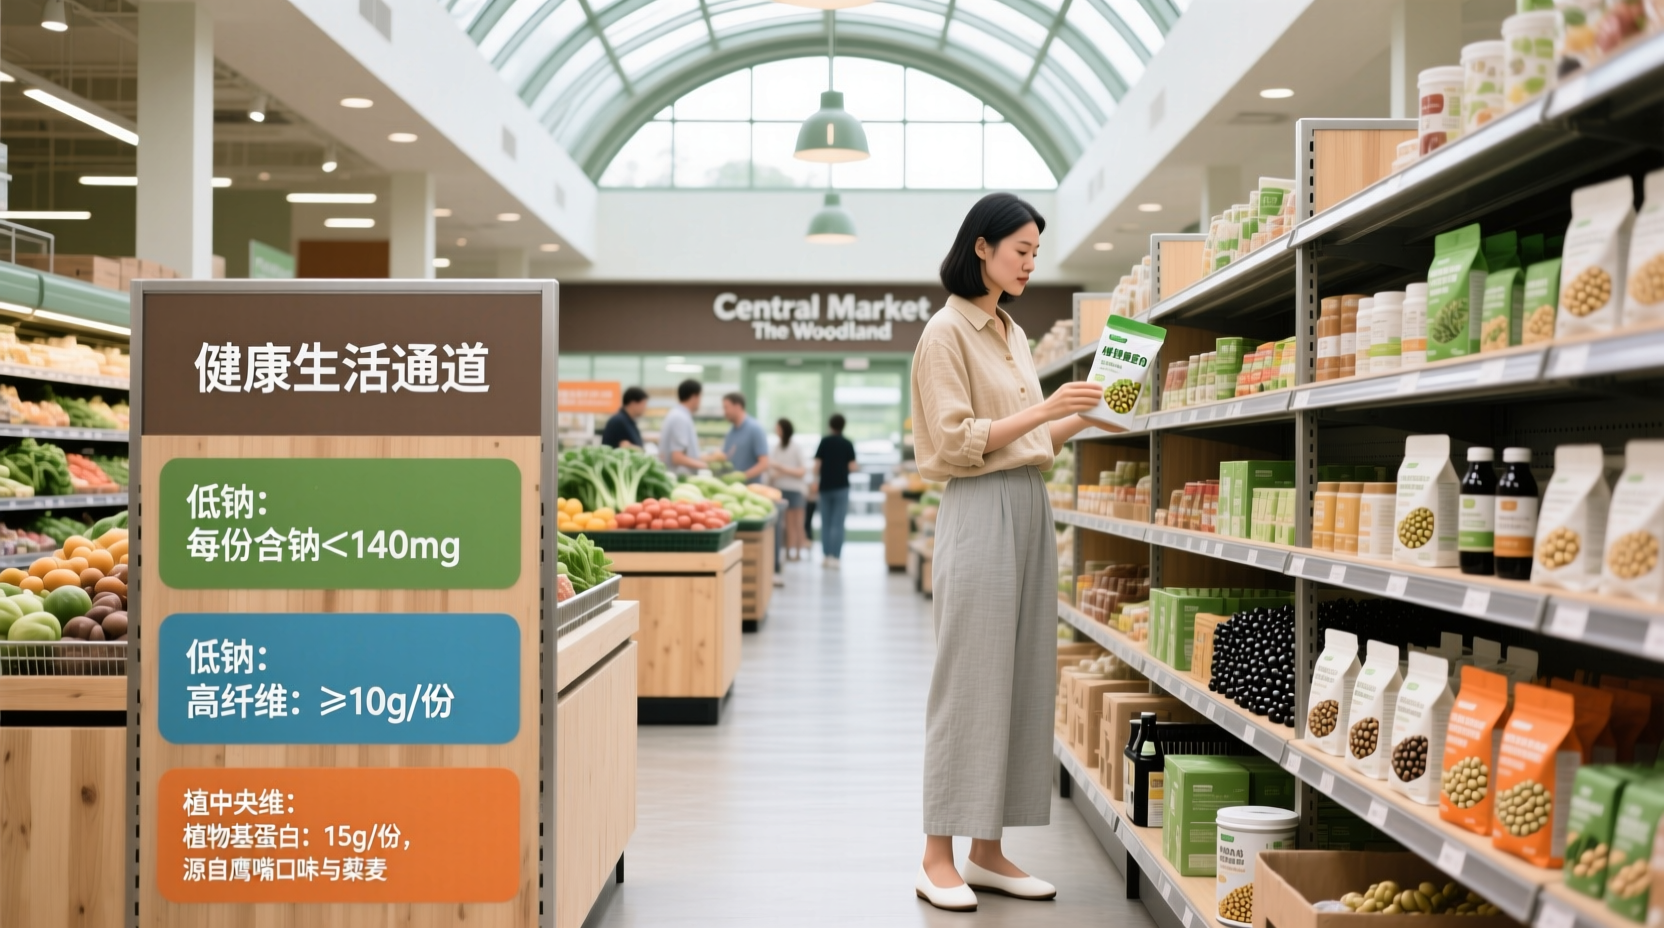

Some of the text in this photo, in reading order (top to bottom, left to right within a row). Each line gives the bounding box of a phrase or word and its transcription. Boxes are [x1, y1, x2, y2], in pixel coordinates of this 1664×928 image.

[713, 292, 931, 321] Central Market
[752, 321, 892, 341] The Woodland
[194, 341, 490, 394] 健康生活通道
[186, 483, 267, 520] 低钠：
[186, 526, 460, 568] 每份含钠<140mg
[186, 638, 267, 675] 低钠：
[182, 788, 294, 817] 植中央维：
